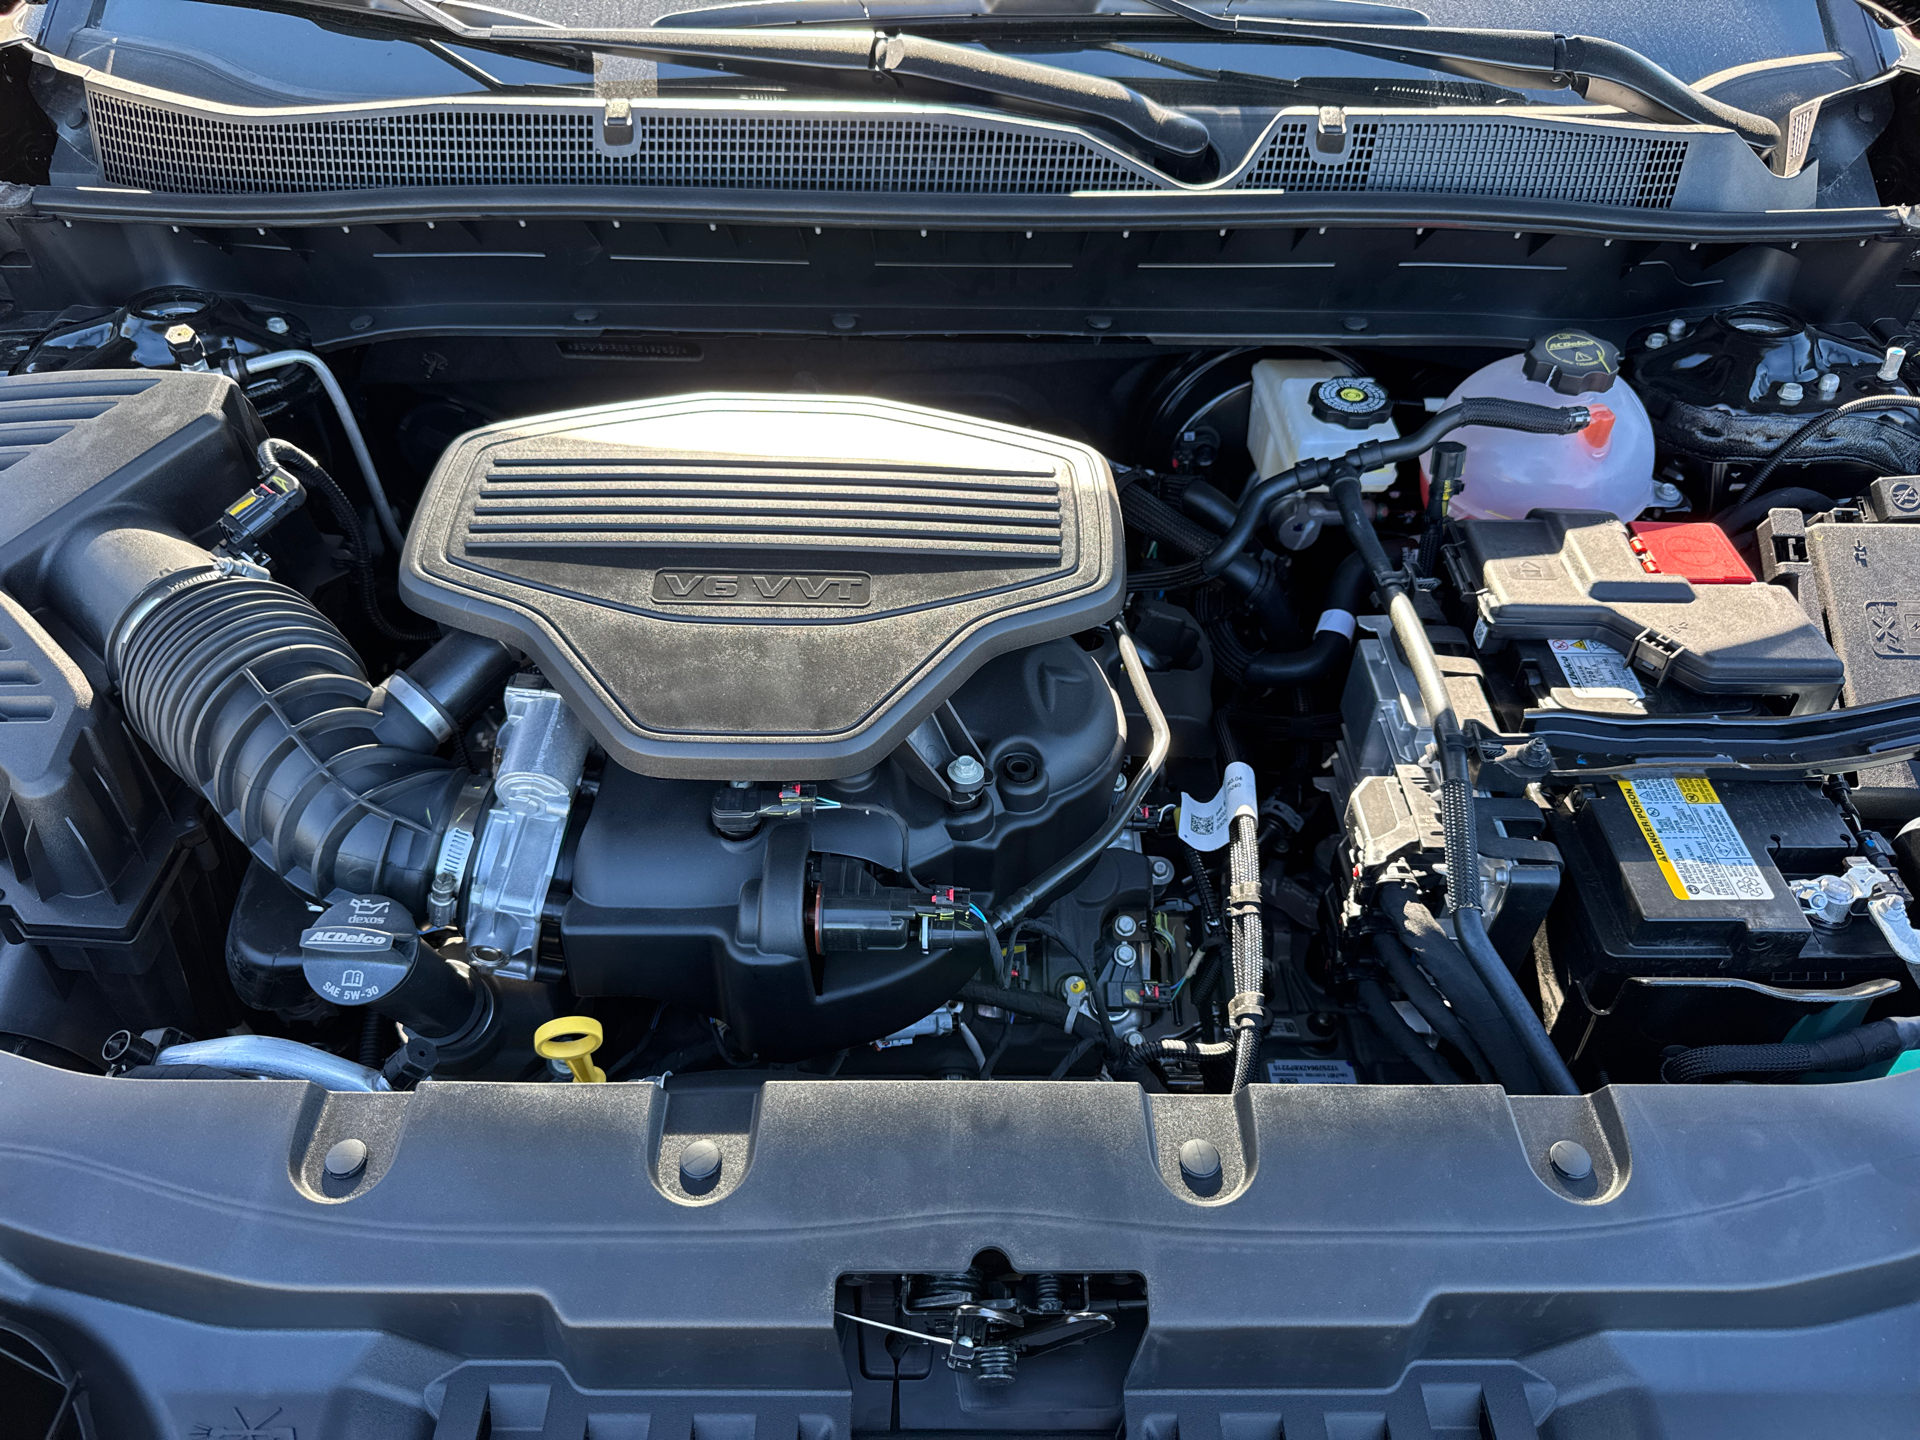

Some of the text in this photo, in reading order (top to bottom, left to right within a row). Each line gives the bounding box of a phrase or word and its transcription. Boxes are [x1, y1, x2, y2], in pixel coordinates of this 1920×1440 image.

[1549, 341, 1596, 350] ACDelco
[664, 574, 862, 600] V6 VVT
[1623, 788, 1664, 855] DANGER/POISON
[348, 915, 386, 924] dexos
[308, 932, 387, 945] ACDelco
[322, 981, 379, 1000] SAE 5W-30
